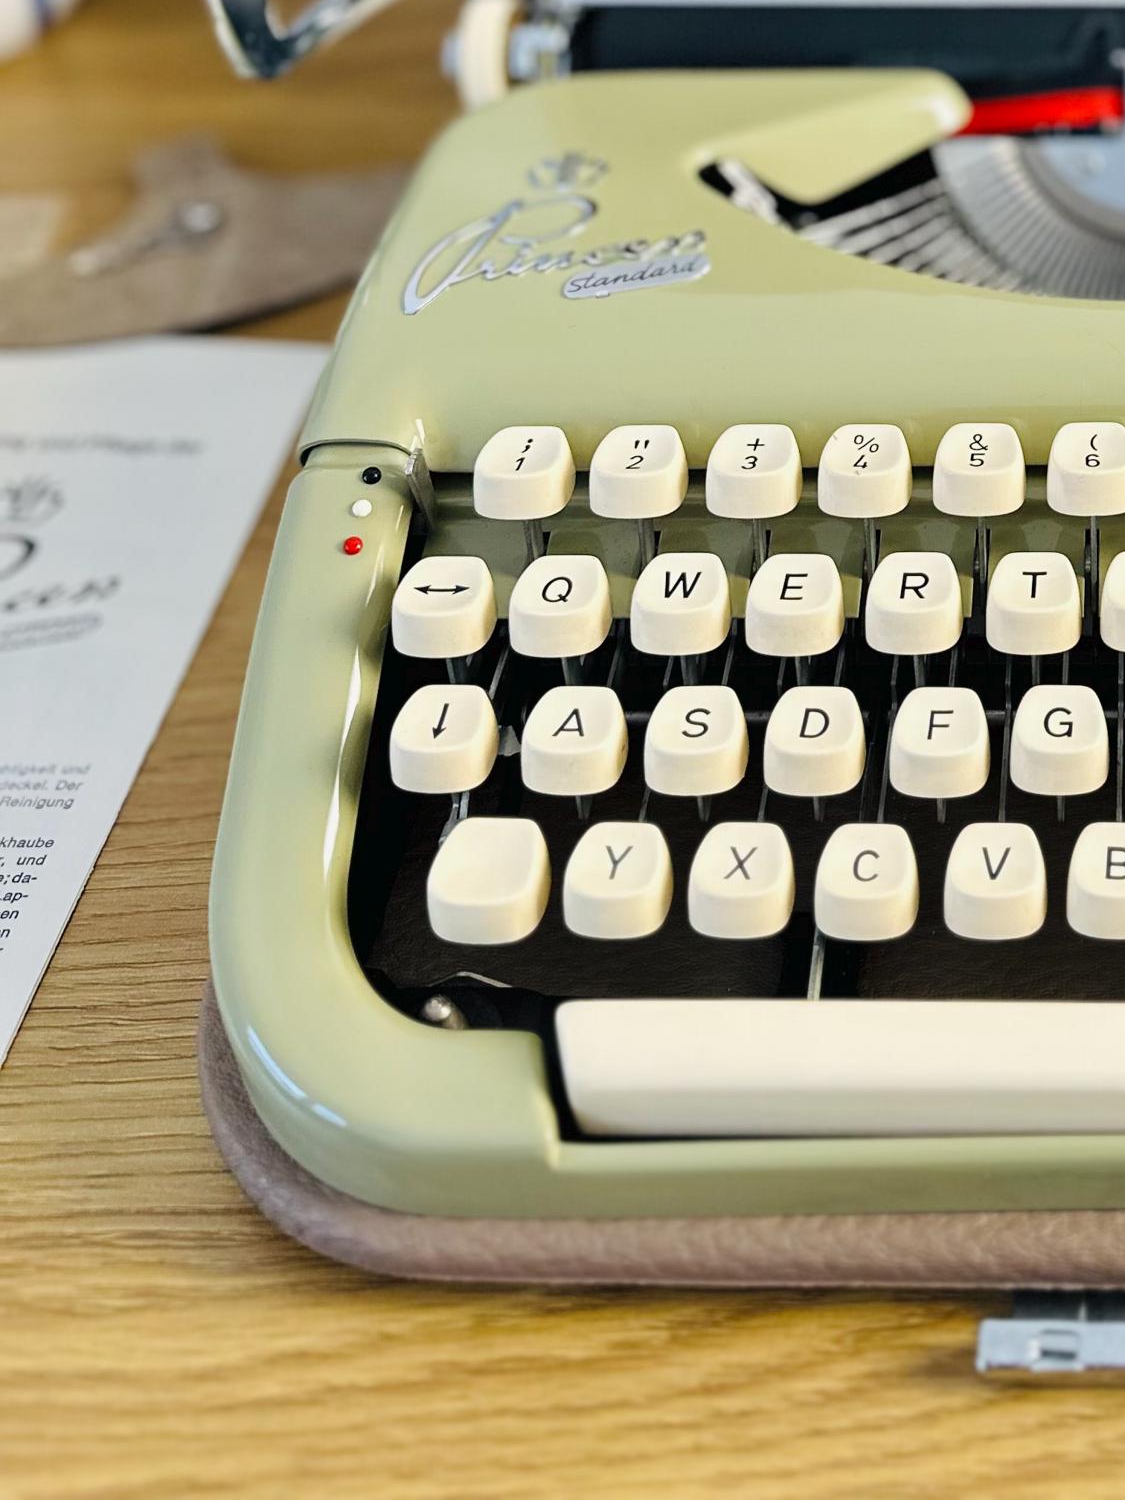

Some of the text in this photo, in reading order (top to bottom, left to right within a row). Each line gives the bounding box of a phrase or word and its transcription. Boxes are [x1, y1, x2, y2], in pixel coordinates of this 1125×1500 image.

[566, 259, 697, 294] Standard
[852, 433, 881, 455] %
[968, 432, 989, 452] &
[514, 456, 526, 472] 1
[624, 454, 645, 470] 2
[739, 455, 759, 470] 3
[852, 454, 868, 470] 4
[968, 452, 986, 468] 5
[1084, 453, 1101, 468] 6
[541, 576, 574, 604] Q
[663, 570, 703, 599] W
[779, 572, 809, 601] E
[899, 571, 930, 600] R
[1021, 571, 1048, 599] T
[551, 707, 585, 738] A
[681, 707, 712, 739] S
[798, 707, 831, 739] D
[926, 709, 955, 741] F
[1043, 706, 1074, 738] G
[56, 779, 84, 791] Der
[0, 796, 75, 810] Reinigung
[16, 854, 47, 866] und
[605, 845, 633, 880] Y
[723, 846, 758, 881] X
[852, 849, 880, 883] C
[981, 846, 1011, 881] V
